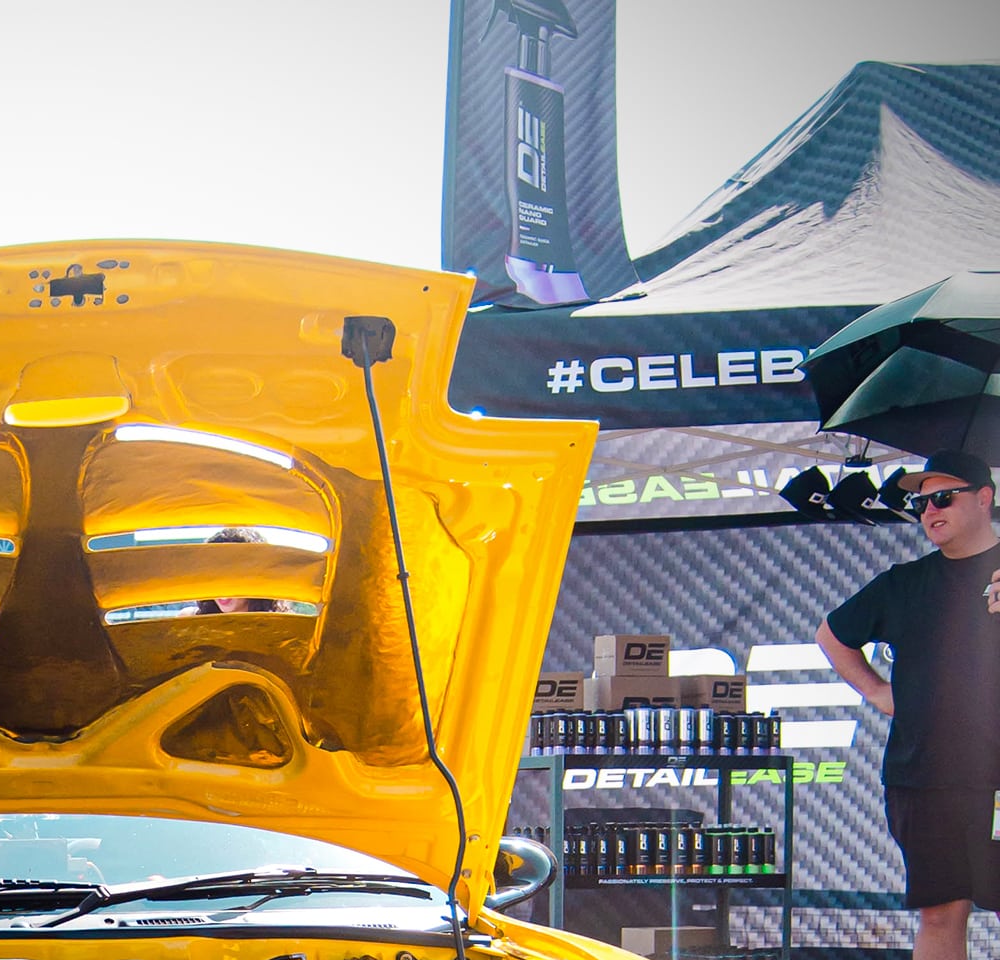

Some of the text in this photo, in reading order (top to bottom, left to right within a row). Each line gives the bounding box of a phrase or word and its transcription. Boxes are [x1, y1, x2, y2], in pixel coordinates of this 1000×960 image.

[519, 200, 554, 214] CERAMIC
[547, 348, 817, 394] #CELEB
[624, 642, 666, 660] DE
[535, 680, 578, 697] DE
[712, 681, 744, 698] DE
